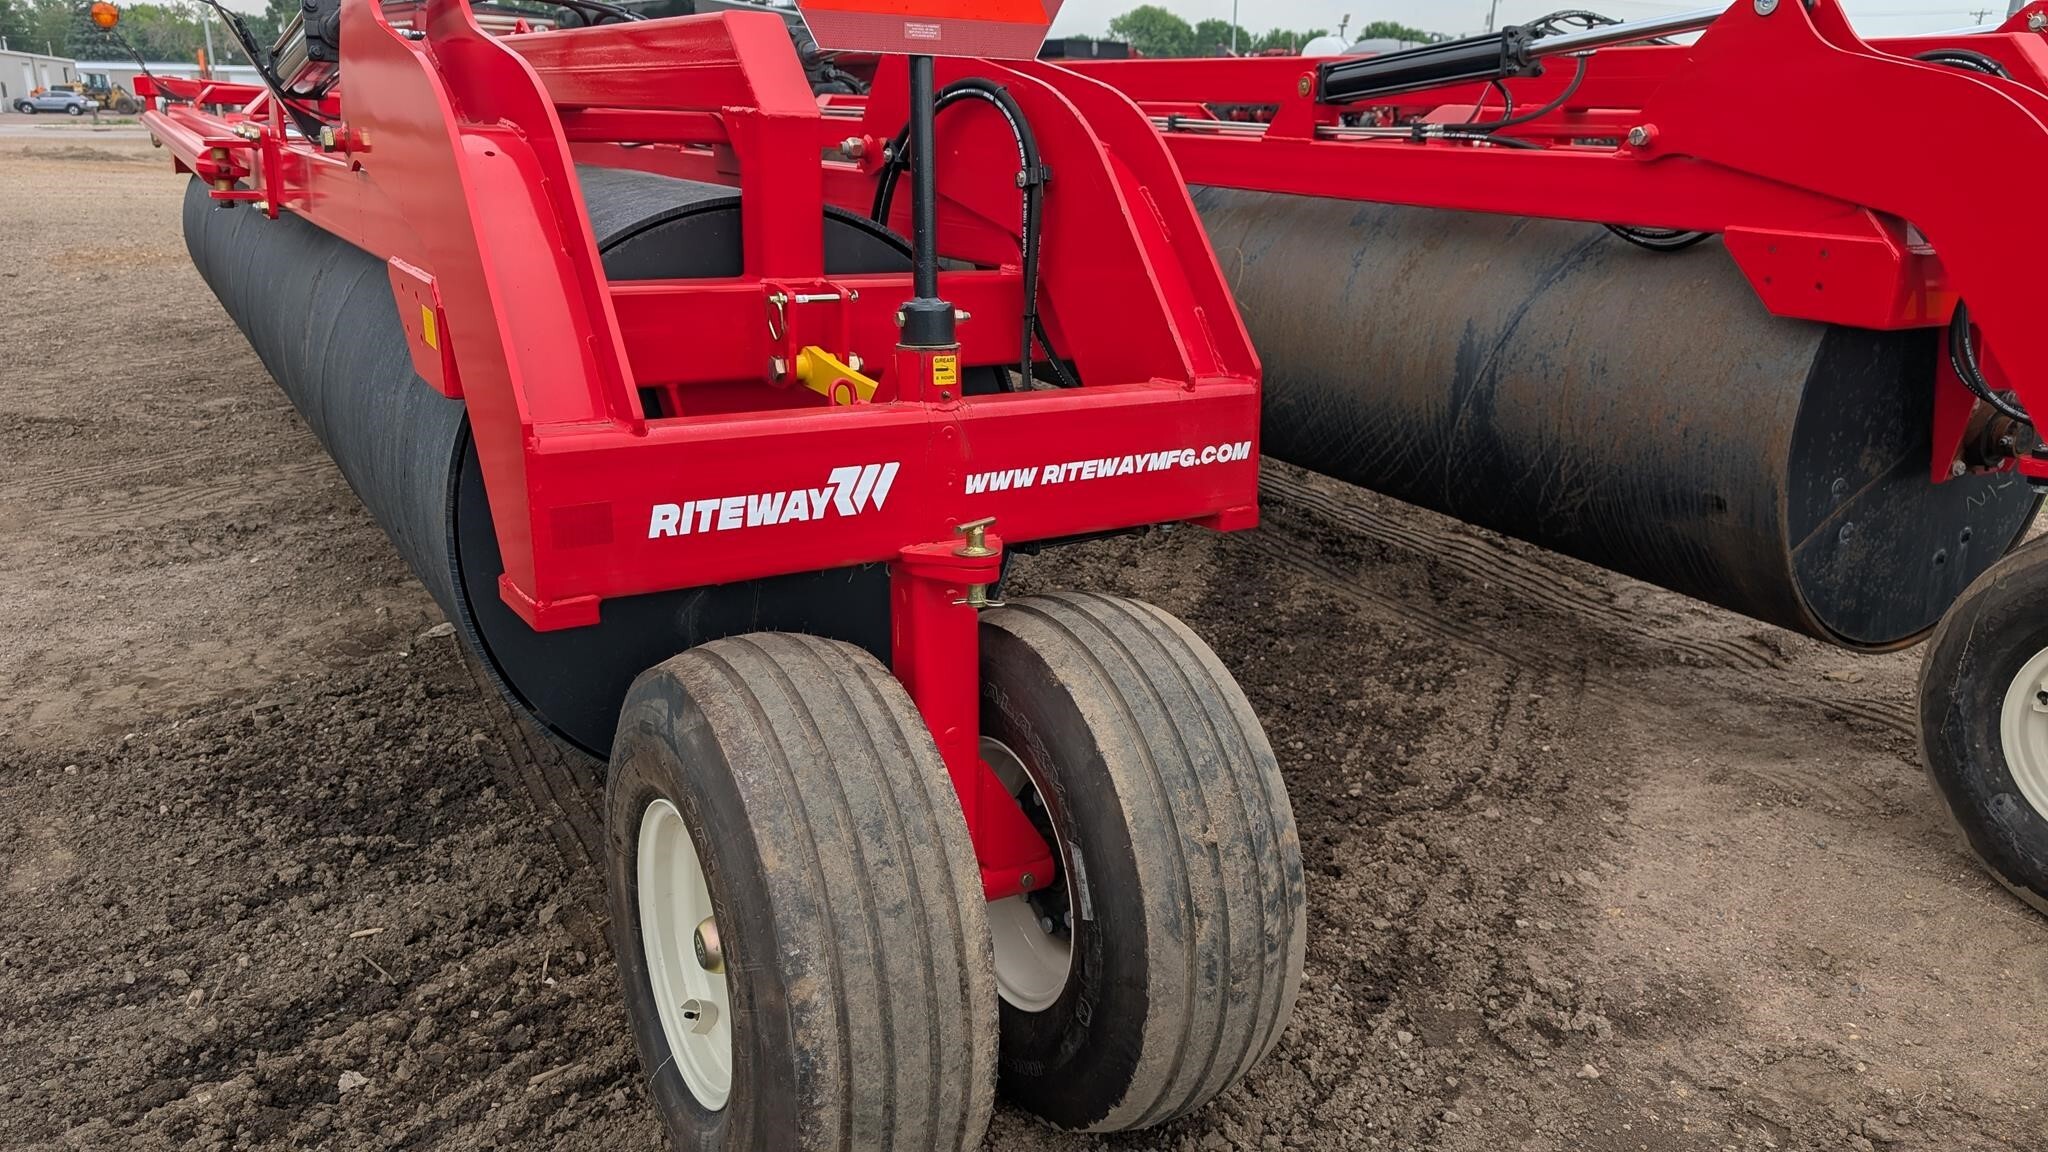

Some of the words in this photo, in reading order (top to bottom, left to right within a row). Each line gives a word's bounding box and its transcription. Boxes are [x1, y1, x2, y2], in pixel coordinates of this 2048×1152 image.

[965, 467, 1037, 495] WWW
[1041, 441, 1251, 485] RITEWAYMFG.COM
[648, 487, 835, 539] RITEWAY
